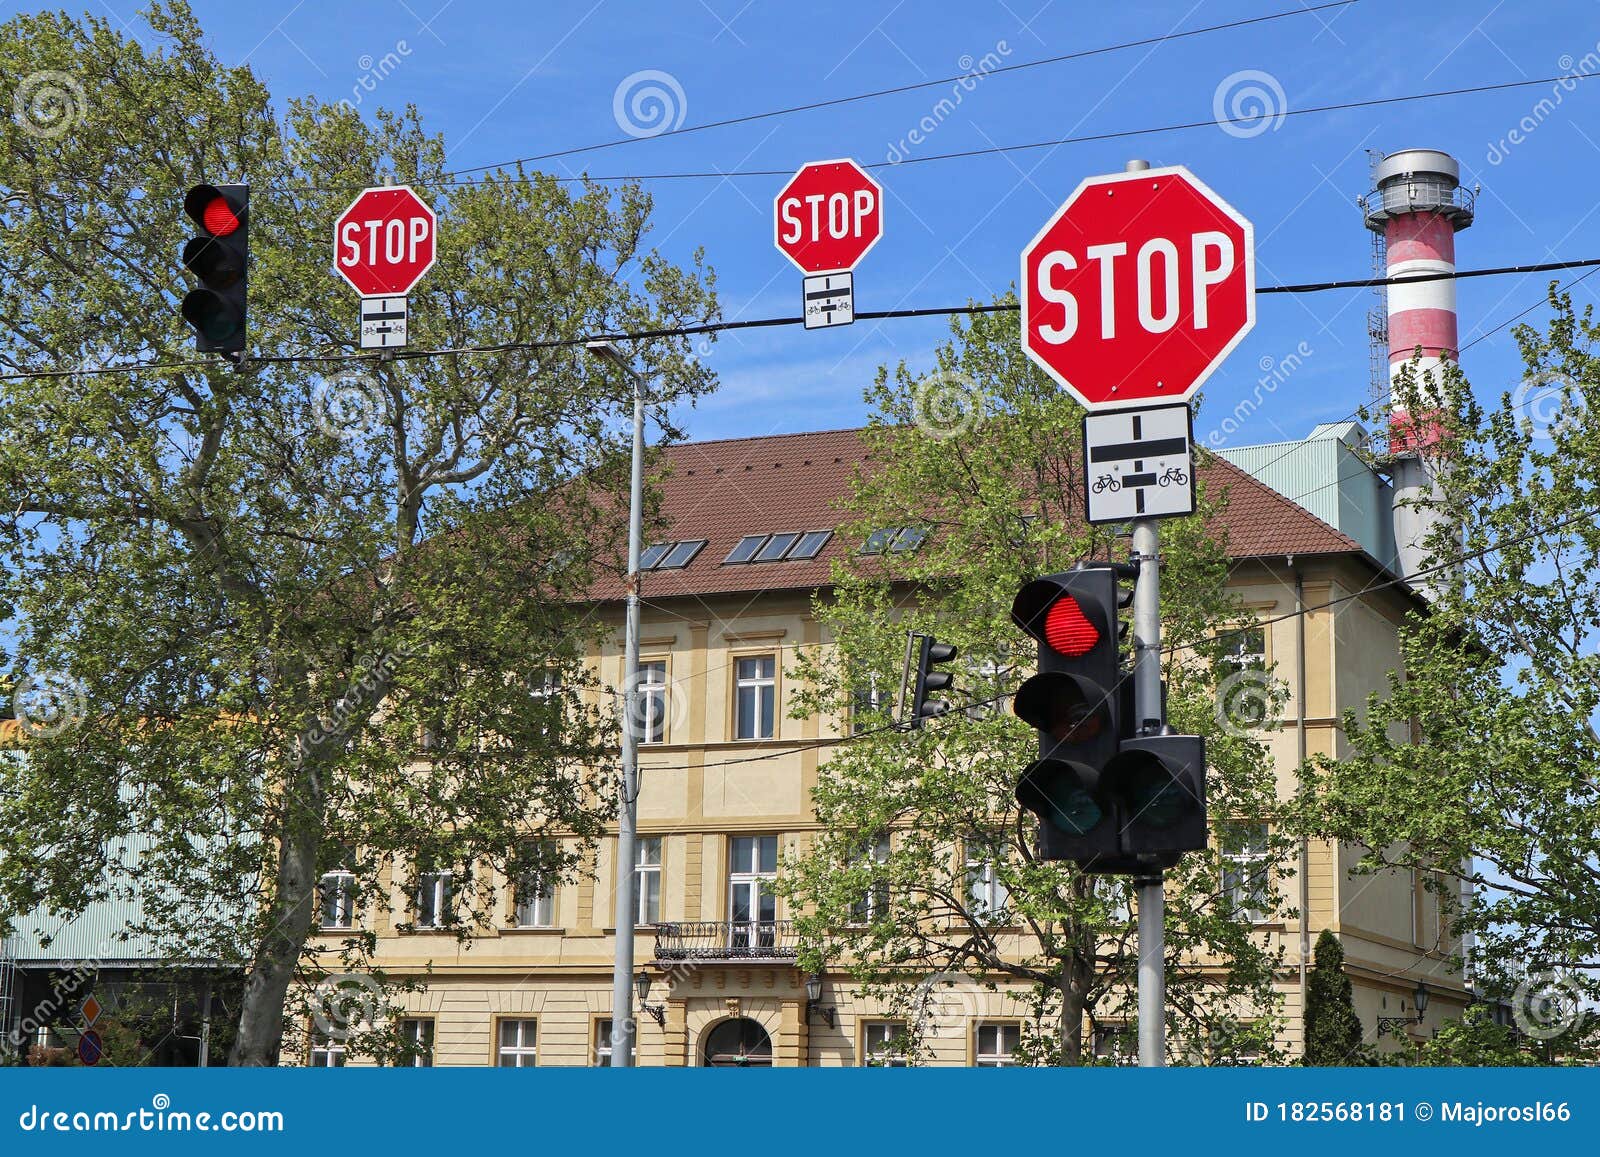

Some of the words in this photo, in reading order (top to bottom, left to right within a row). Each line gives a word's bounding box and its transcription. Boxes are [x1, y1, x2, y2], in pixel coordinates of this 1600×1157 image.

[341, 217, 429, 267] STOP
[782, 189, 875, 244] STOP
[1037, 230, 1235, 345] STOP
